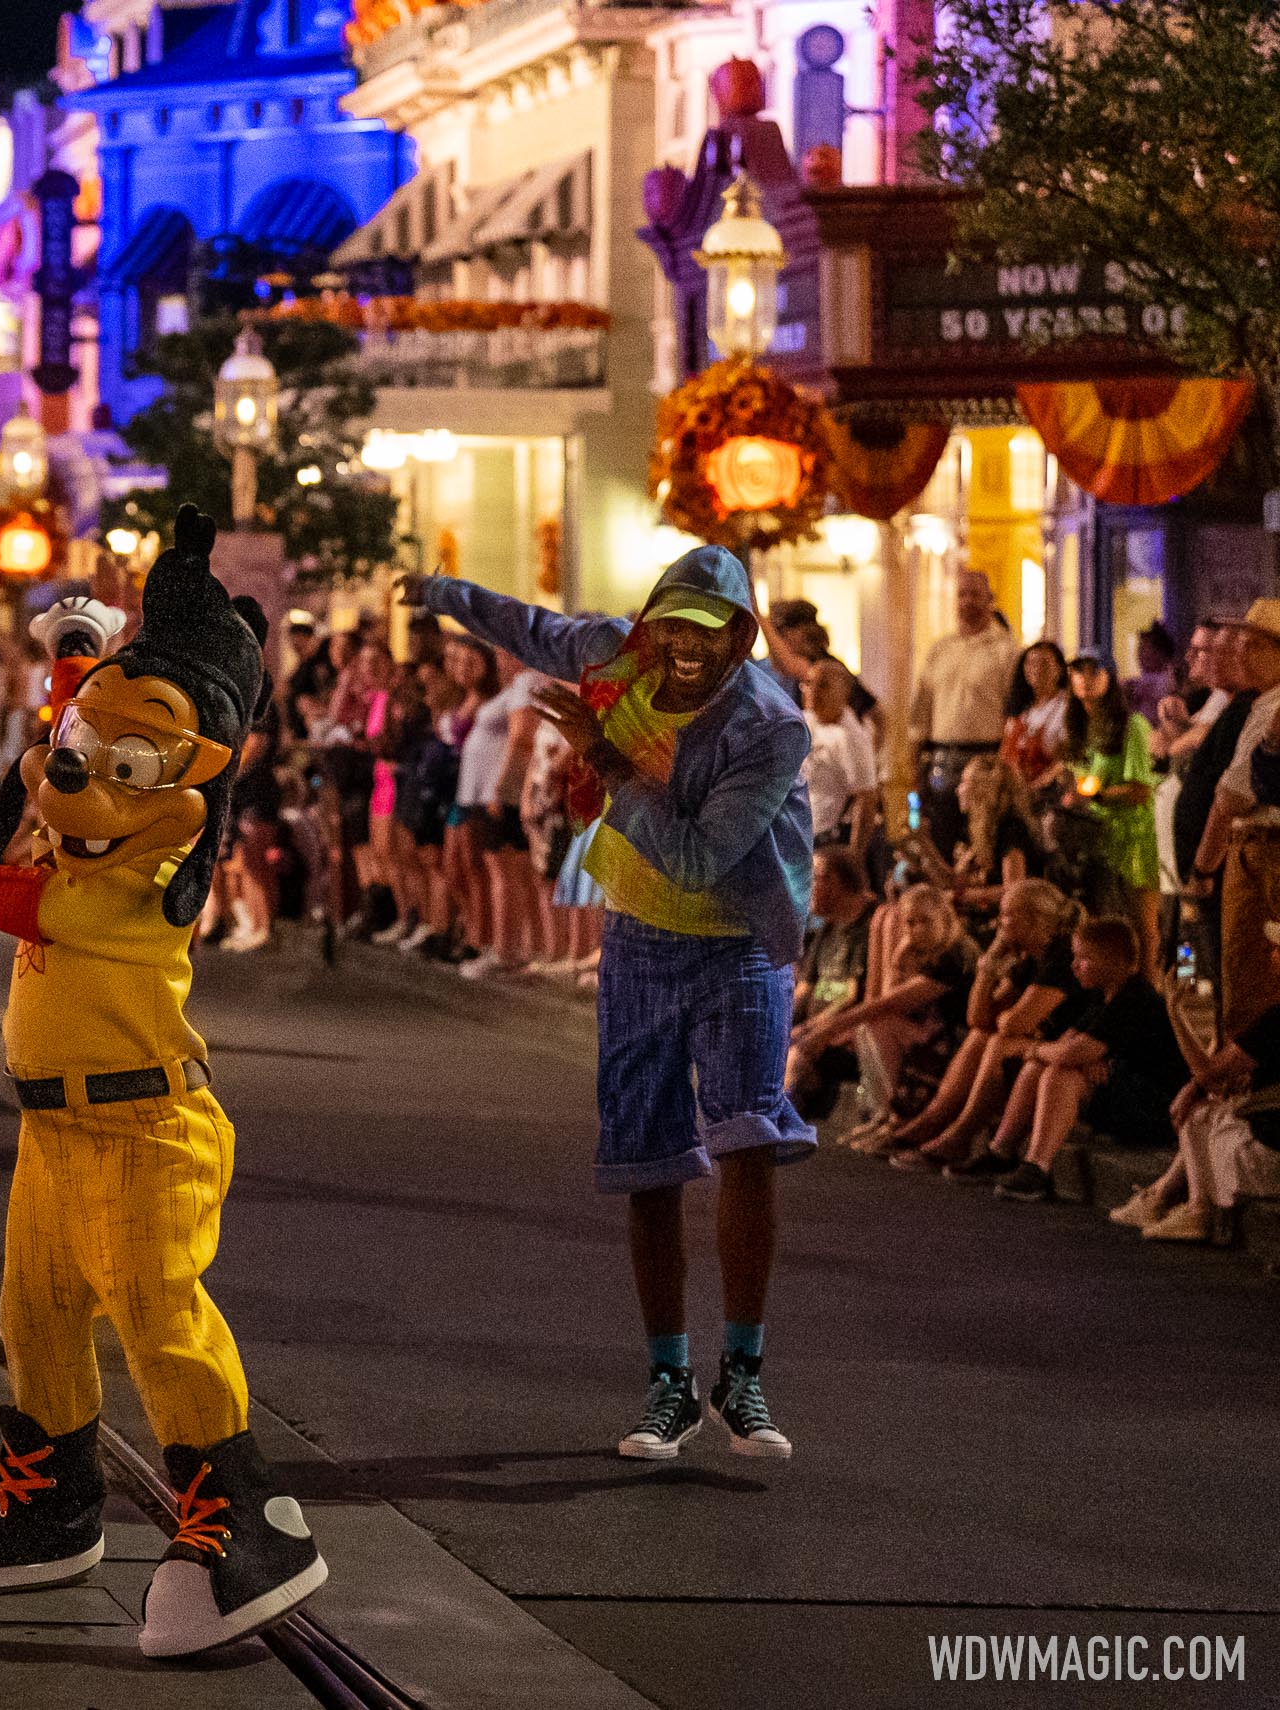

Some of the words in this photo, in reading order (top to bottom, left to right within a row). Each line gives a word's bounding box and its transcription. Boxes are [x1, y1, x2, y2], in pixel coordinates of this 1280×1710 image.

[997, 263, 1081, 296] NOW
[940, 308, 990, 341] 50
[1003, 305, 1128, 339] YEARS
